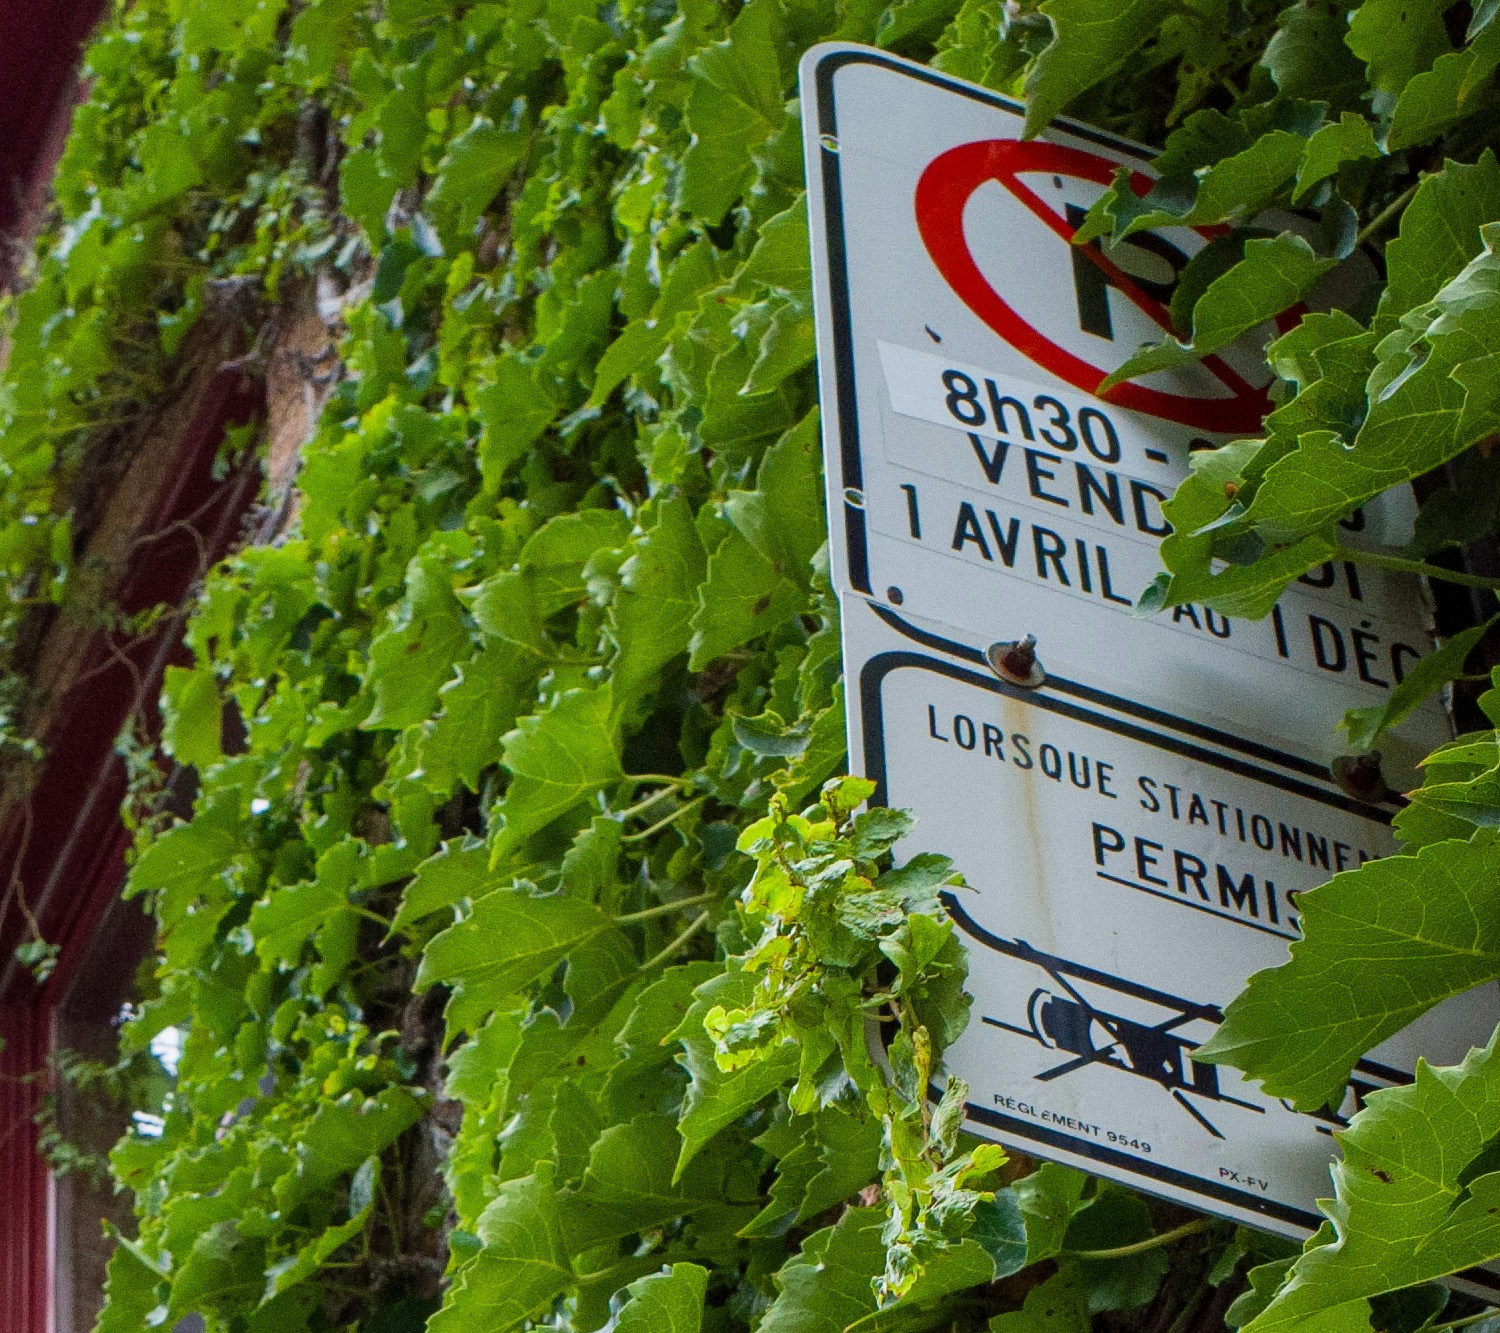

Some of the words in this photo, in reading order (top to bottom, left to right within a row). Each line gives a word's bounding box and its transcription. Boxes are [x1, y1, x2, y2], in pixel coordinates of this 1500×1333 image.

[940, 368, 1122, 465] 8h30
[900, 483, 921, 540] 1
[951, 501, 1132, 607] AVRIL
[1173, 603, 1232, 639] AU
[927, 703, 1118, 799] LORSQUE
[1106, 1131, 1152, 1153] 9549
